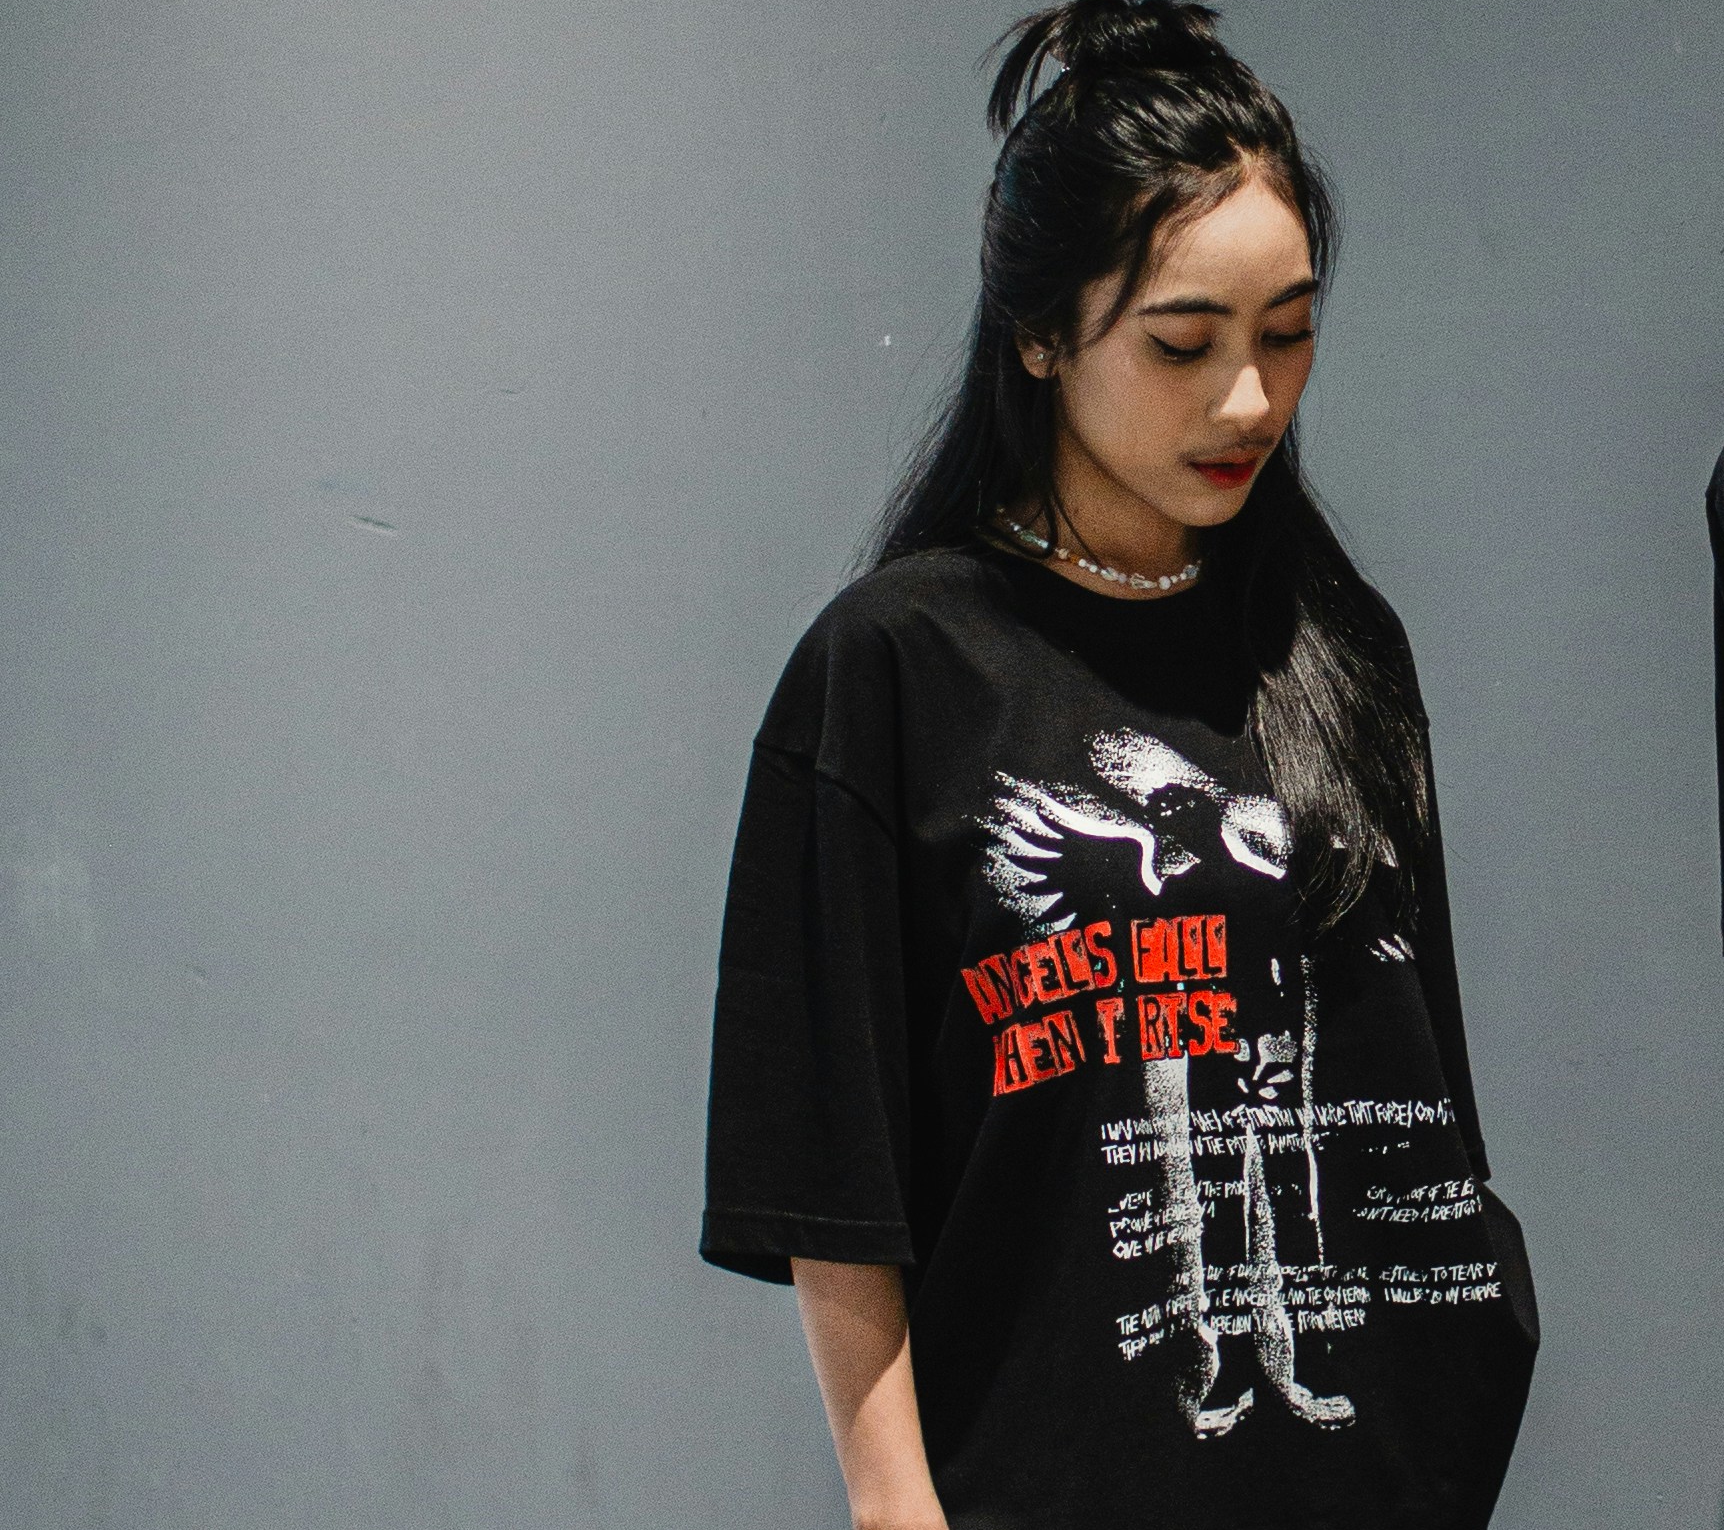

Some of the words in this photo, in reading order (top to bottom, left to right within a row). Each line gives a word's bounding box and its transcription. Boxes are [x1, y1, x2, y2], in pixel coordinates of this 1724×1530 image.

[1131, 914, 1227, 983] FALL
[1096, 997, 1125, 1064] I
[1136, 990, 1239, 1061] RISE
[1431, 1266, 1447, 1282] TO
[1449, 1262, 1485, 1282] TEAR
